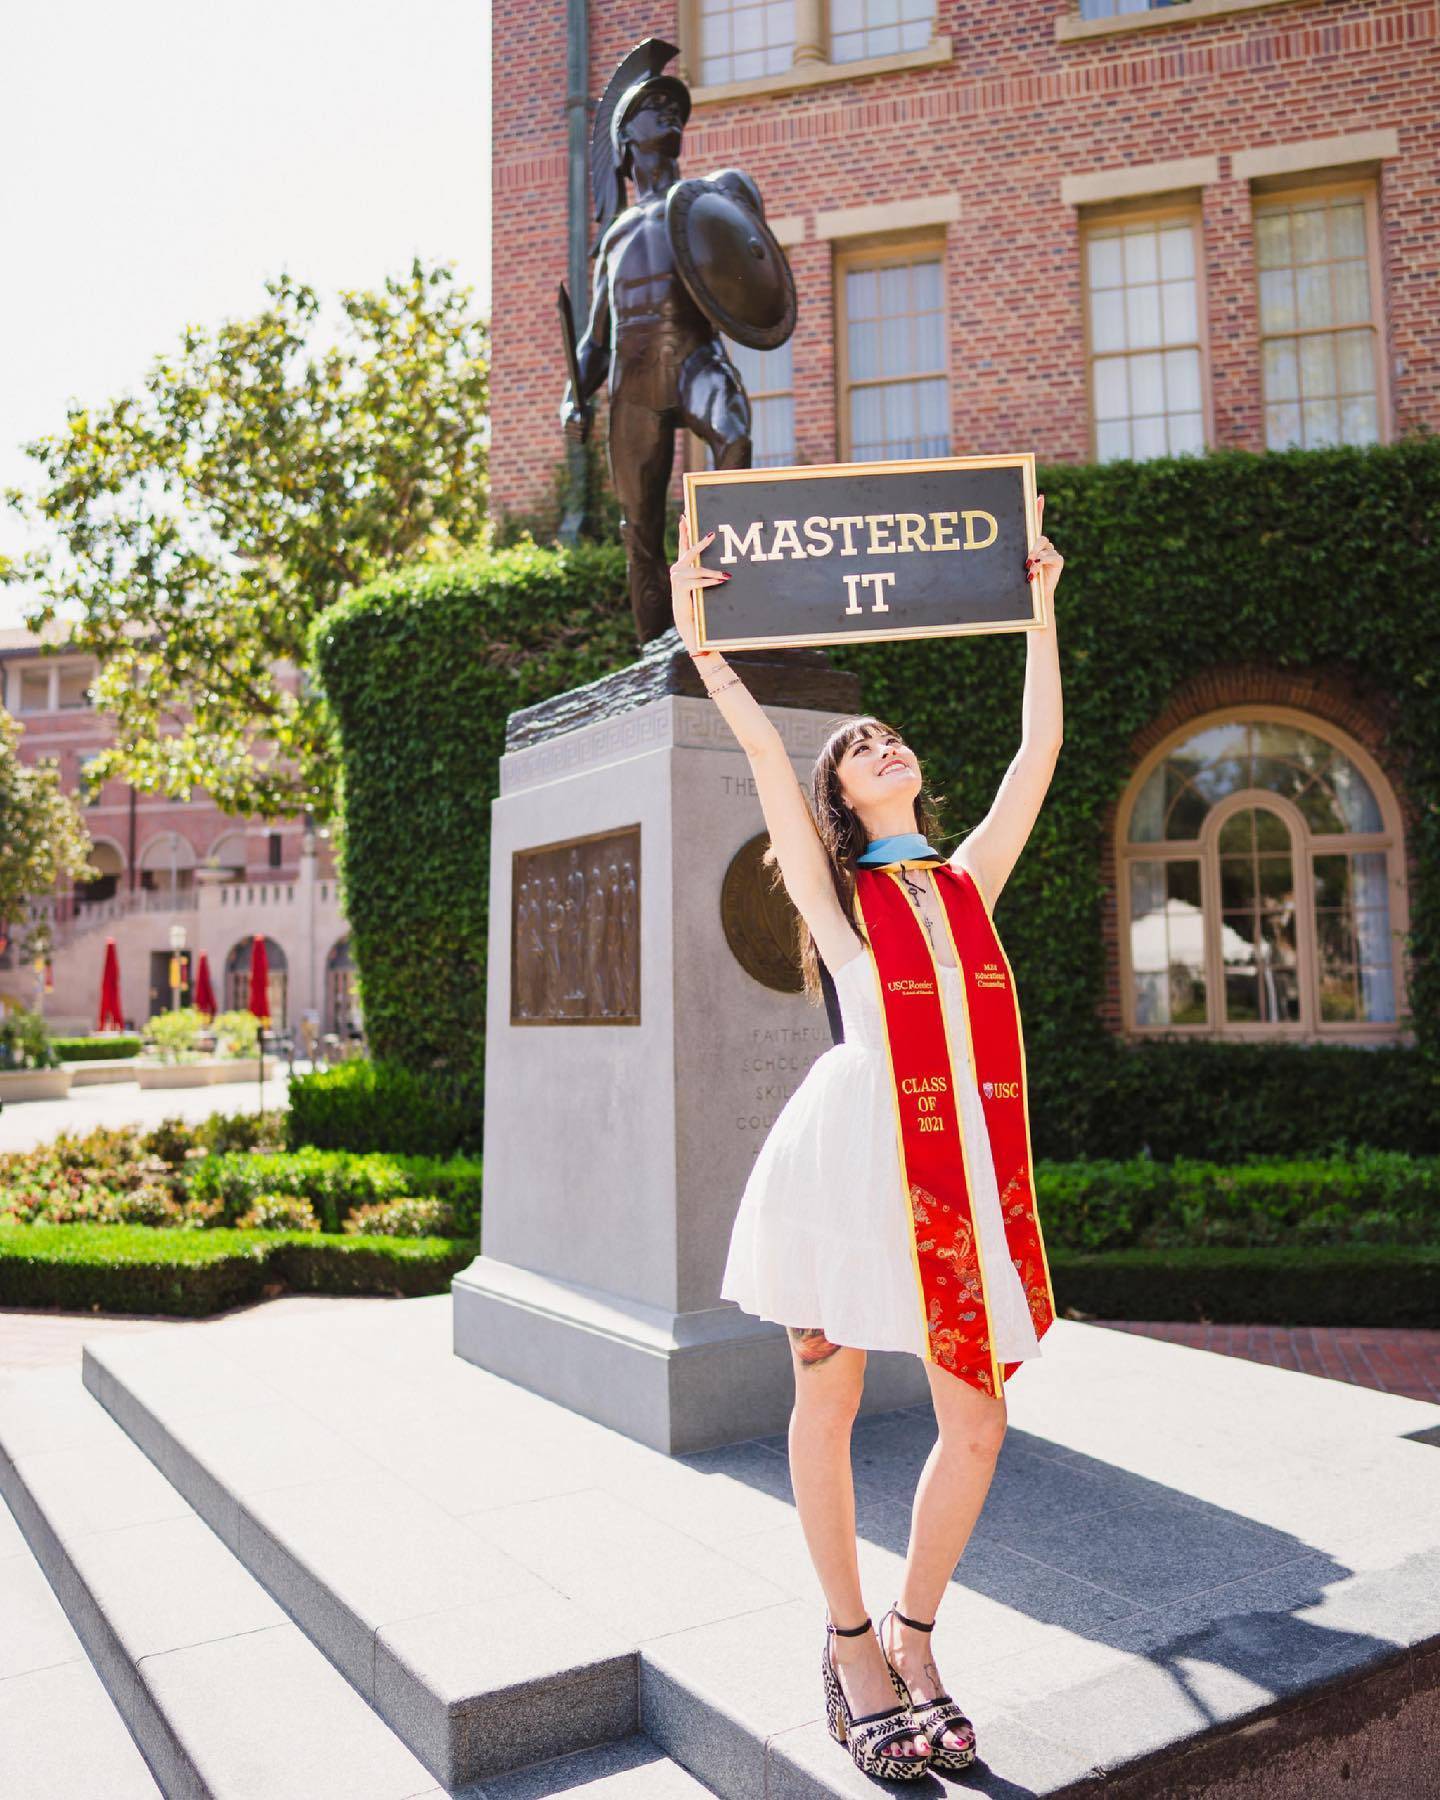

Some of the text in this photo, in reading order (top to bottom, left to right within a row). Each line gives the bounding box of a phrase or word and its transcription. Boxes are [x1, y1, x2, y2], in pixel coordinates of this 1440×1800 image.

[718, 510, 998, 564] MASTERED
[842, 572, 896, 615] IT
[720, 776, 759, 797] THE
[887, 979, 908, 992] USC
[753, 1028, 829, 1043] FAITHFUL
[743, 1056, 814, 1073] SCHOLA
[756, 1085, 793, 1101] SKIL
[901, 1076, 947, 1094] CLASS
[993, 1083, 1019, 1099] USC
[918, 1096, 937, 1112] OF
[917, 1116, 944, 1133] 2021
